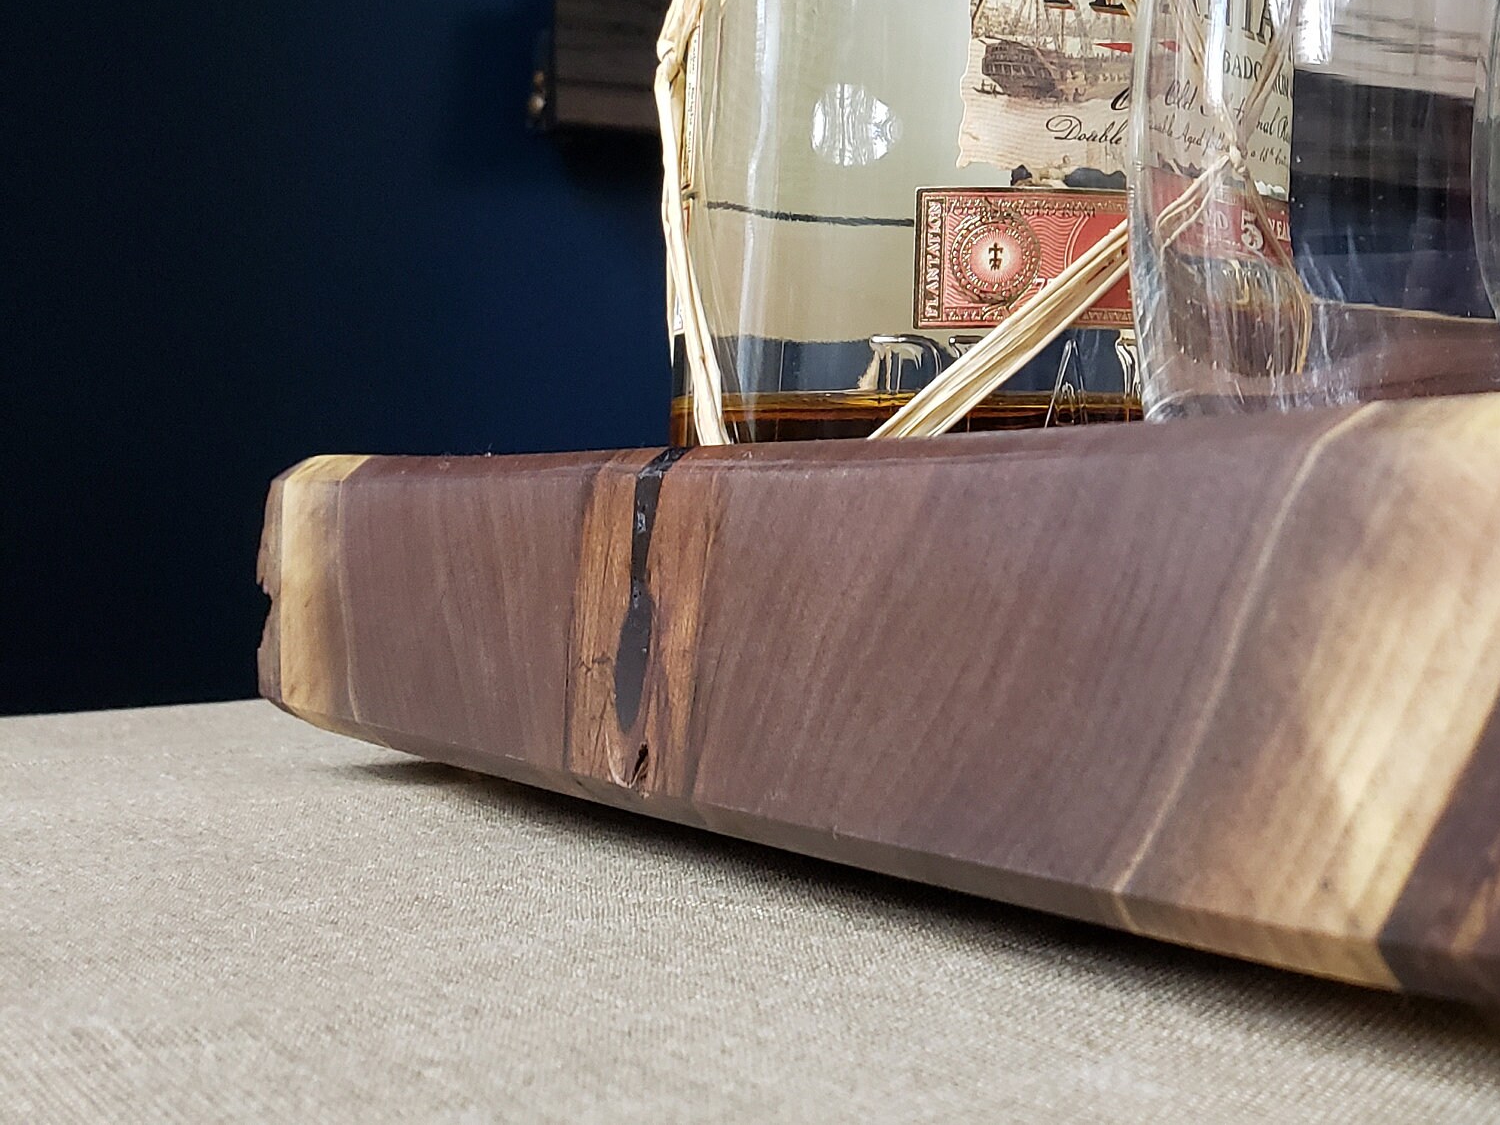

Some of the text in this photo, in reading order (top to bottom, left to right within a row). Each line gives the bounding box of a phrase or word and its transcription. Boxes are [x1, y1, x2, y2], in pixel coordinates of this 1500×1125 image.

[1046, 114, 1129, 145] Double
[1241, 209, 1264, 251] 5
[926, 201, 943, 318] PLANTATION
